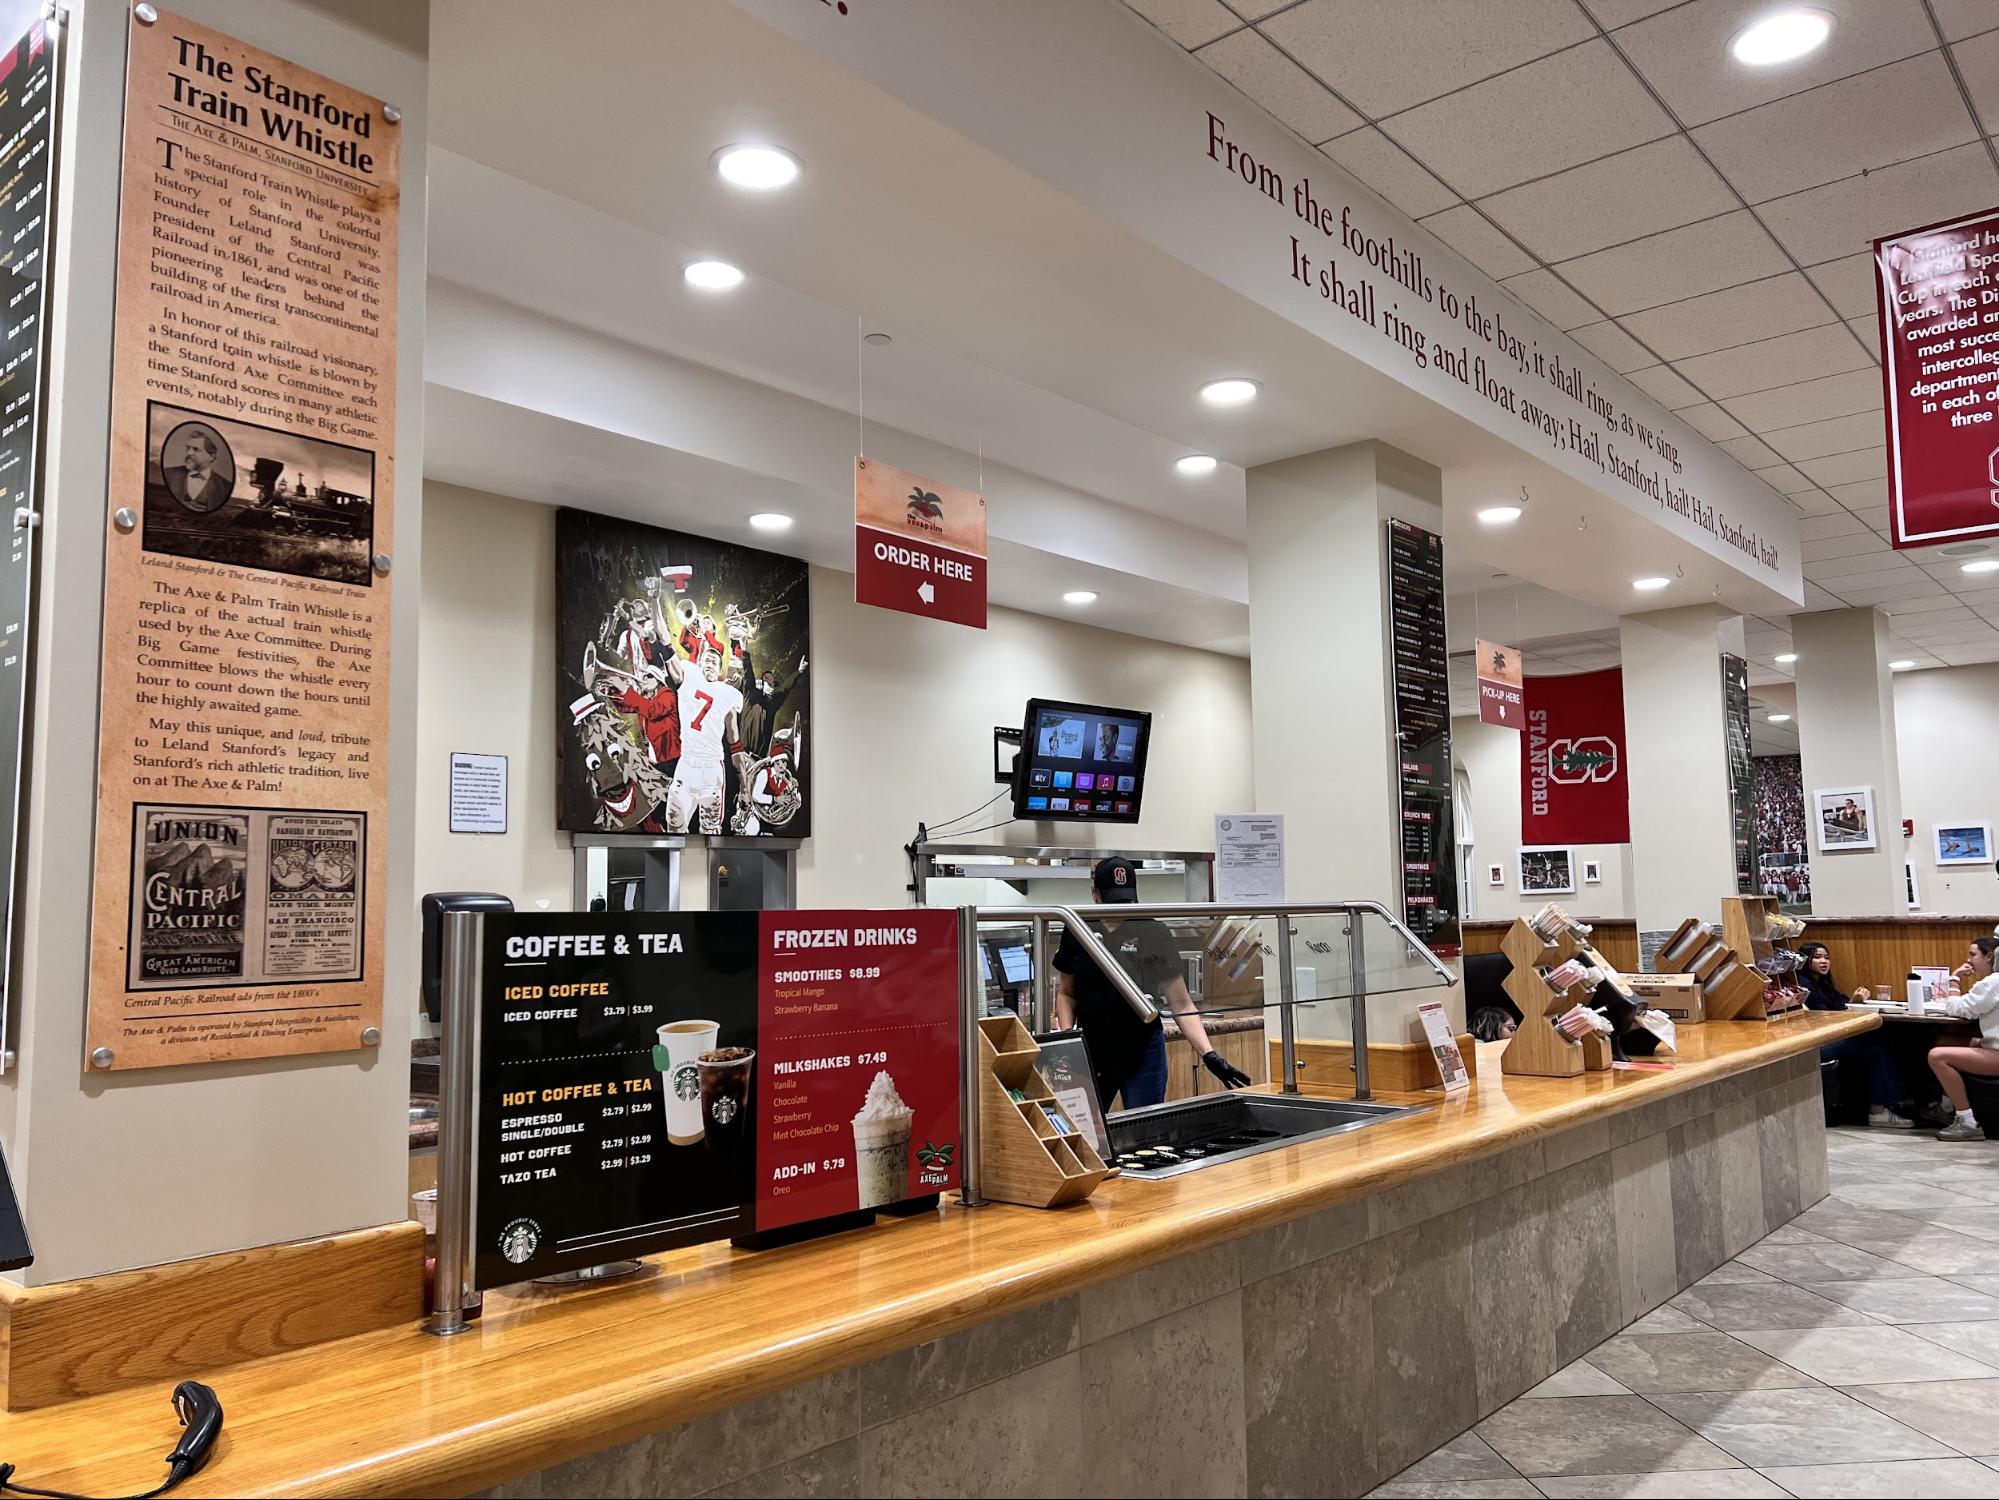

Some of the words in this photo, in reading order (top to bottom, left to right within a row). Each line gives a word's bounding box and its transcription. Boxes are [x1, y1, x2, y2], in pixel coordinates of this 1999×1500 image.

[173, 35, 232, 82] The
[244, 66, 369, 138] Stanford
[168, 72, 247, 126] Train
[260, 108, 372, 173] Whistle
[172, 114, 190, 130] THE
[194, 123, 212, 139] AXE
[218, 132, 227, 144] &
[232, 136, 260, 158] PALM,
[265, 148, 311, 174] STANFORD
[316, 167, 367, 196] UNIVERSITY
[156, 136, 200, 171] The
[203, 153, 256, 182] Stanford
[260, 173, 291, 195] Train
[295, 185, 339, 211] Whistle
[342, 205, 372, 222] plays
[374, 217, 380, 226] a
[1206, 111, 1284, 206] From
[1294, 179, 1333, 236] the
[1341, 206, 1432, 302] foothills
[1439, 284, 1458, 319] to
[1465, 296, 1492, 342] the
[1496, 314, 1530, 374] bay,
[1534, 341, 1544, 378] it
[1550, 356, 1583, 403] shall
[1587, 382, 1618, 432] ring,
[1622, 412, 1633, 436] as
[1637, 422, 1653, 450] we
[1657, 430, 1682, 474] sing,
[1898, 287, 1928, 304] Cup
[1933, 282, 1947, 296] in
[1952, 271, 1989, 291] each
[1898, 306, 1943, 328] years.
[1948, 295, 1976, 311] The
[1907, 311, 1978, 340] awarded
[162, 306, 177, 321] In
[181, 311, 222, 332] honor
[224, 326, 239, 338] of
[242, 329, 266, 345] this
[268, 337, 318, 359] railroad
[322, 353, 378, 376] visionary,
[1918, 339, 1955, 357] most
[1290, 235, 1311, 286] It
[1320, 261, 1376, 327] shall
[1383, 303, 1425, 368] ring
[1434, 343, 1470, 384] and
[1474, 356, 1516, 414] float
[1521, 400, 1566, 450] away;
[1568, 419, 1604, 473] Hail,
[1608, 444, 1664, 509] Stanford,
[1666, 479, 1690, 518] hail!
[1692, 496, 1718, 540] Hail,
[1720, 514, 1759, 564] Stanford,
[1762, 539, 1778, 571] hail!
[1922, 400, 1937, 413] in
[1942, 390, 1980, 409] each
[1951, 411, 1992, 427] three
[874, 542, 930, 572] ORDER
[934, 557, 972, 582] HERE
[152, 580, 180, 595] The
[183, 586, 211, 600] Axe
[214, 590, 226, 602] &
[230, 591, 263, 607] Palm
[266, 597, 299, 613] Train
[303, 602, 349, 619] Whistle
[352, 610, 362, 621] is
[364, 614, 372, 623] a
[1482, 686, 1504, 700] PICK-UP
[1505, 691, 1520, 704] HERE
[690, 690, 714, 732] 7
[149, 717, 180, 734] May
[186, 720, 211, 735] this
[216, 724, 264, 740] unique,
[269, 728, 293, 742] and
[298, 729, 326, 744] loud,
[330, 732, 370, 745] tribute
[1529, 710, 1549, 816] STANFORD
[152, 817, 239, 846] UNION
[144, 871, 242, 911] CENTRAL
[146, 912, 240, 928] PACIFIC
[506, 934, 606, 958] COFFEE
[613, 934, 630, 955] &
[639, 933, 683, 955] TEA
[774, 929, 848, 948] FROZEN
[854, 928, 917, 946] DRINKS
[146, 956, 181, 971] GREAT
[184, 954, 235, 968] AMERICAN
[774, 969, 842, 983] SMOOTHIES
[850, 967, 880, 979] $8.99
[124, 996, 161, 1008] Central
[163, 994, 194, 1007] Pacific
[196, 992, 235, 1004] Railroad
[236, 991, 252, 1001] ads
[252, 991, 274, 1003] from
[275, 990, 290, 1000] the
[292, 988, 319, 998] 1800's
[505, 986, 543, 1000] ICED
[549, 982, 609, 998] COFFEE
[774, 988, 801, 999] Tropical
[802, 987, 825, 997] Mango
[504, 1010, 531, 1022] ICED
[534, 1008, 578, 1020] COFFEE
[604, 1005, 625, 1016] $3.79
[632, 1005, 653, 1015] $3.99
[774, 1004, 812, 1015] Strawberry
[813, 1002, 838, 1012] Banana
[774, 1056, 850, 1074] MILKSHAKES
[858, 1052, 887, 1064] $7.49
[503, 1090, 535, 1107] HOT
[542, 1083, 602, 1103] COFFEE
[608, 1082, 618, 1095] &
[624, 1078, 652, 1093] TEA
[774, 1079, 796, 1090] Vanilla
[774, 1095, 808, 1107] Chocolate
[501, 1113, 562, 1129] ESPRESSO
[602, 1106, 624, 1118] $2.79
[631, 1103, 652, 1114] $2.99
[774, 1111, 812, 1124] Strawberry
[501, 1123, 585, 1142] SINGLE/DOUBLE
[773, 1130, 788, 1140] Mint
[790, 1126, 823, 1138] Chocolate
[824, 1123, 839, 1134] Chip
[501, 1152, 525, 1164] HOT
[528, 1145, 572, 1160] COFFEE
[601, 1138, 623, 1150] $2.79
[630, 1134, 652, 1146] $2.99
[500, 1171, 531, 1185] TAZO
[534, 1168, 556, 1180] TEA
[601, 1158, 622, 1170] $2.99
[630, 1154, 651, 1166] $3.29
[773, 1162, 816, 1180] ADD-IN
[823, 1158, 844, 1170] $.79
[773, 1185, 790, 1196] Oreo
